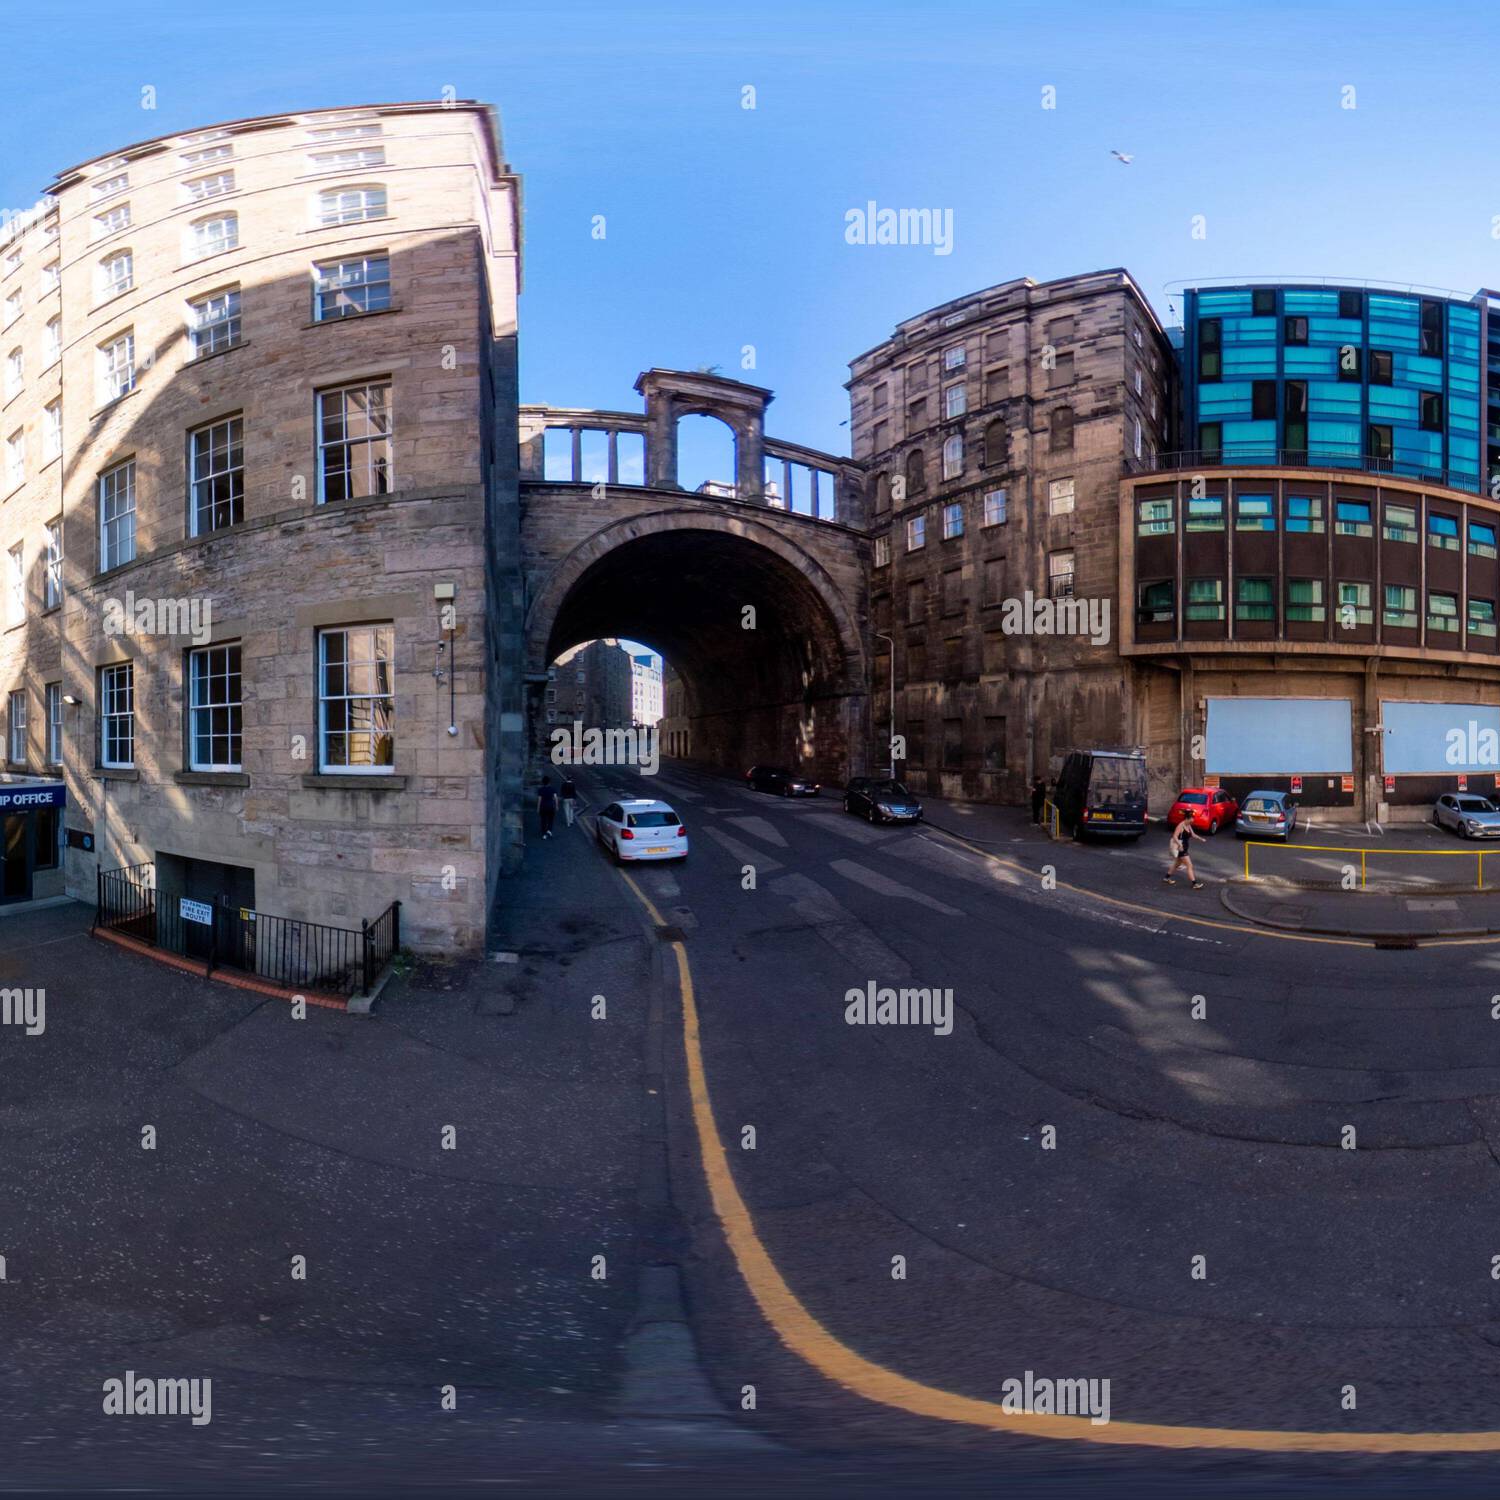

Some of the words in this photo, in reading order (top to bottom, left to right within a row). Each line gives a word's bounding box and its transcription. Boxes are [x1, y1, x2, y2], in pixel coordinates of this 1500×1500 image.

[13, 793, 53, 805] OFFICE
[182, 905, 195, 913] FIRE
[196, 909, 210, 917] EXIT
[185, 912, 205, 922] ROUTE
